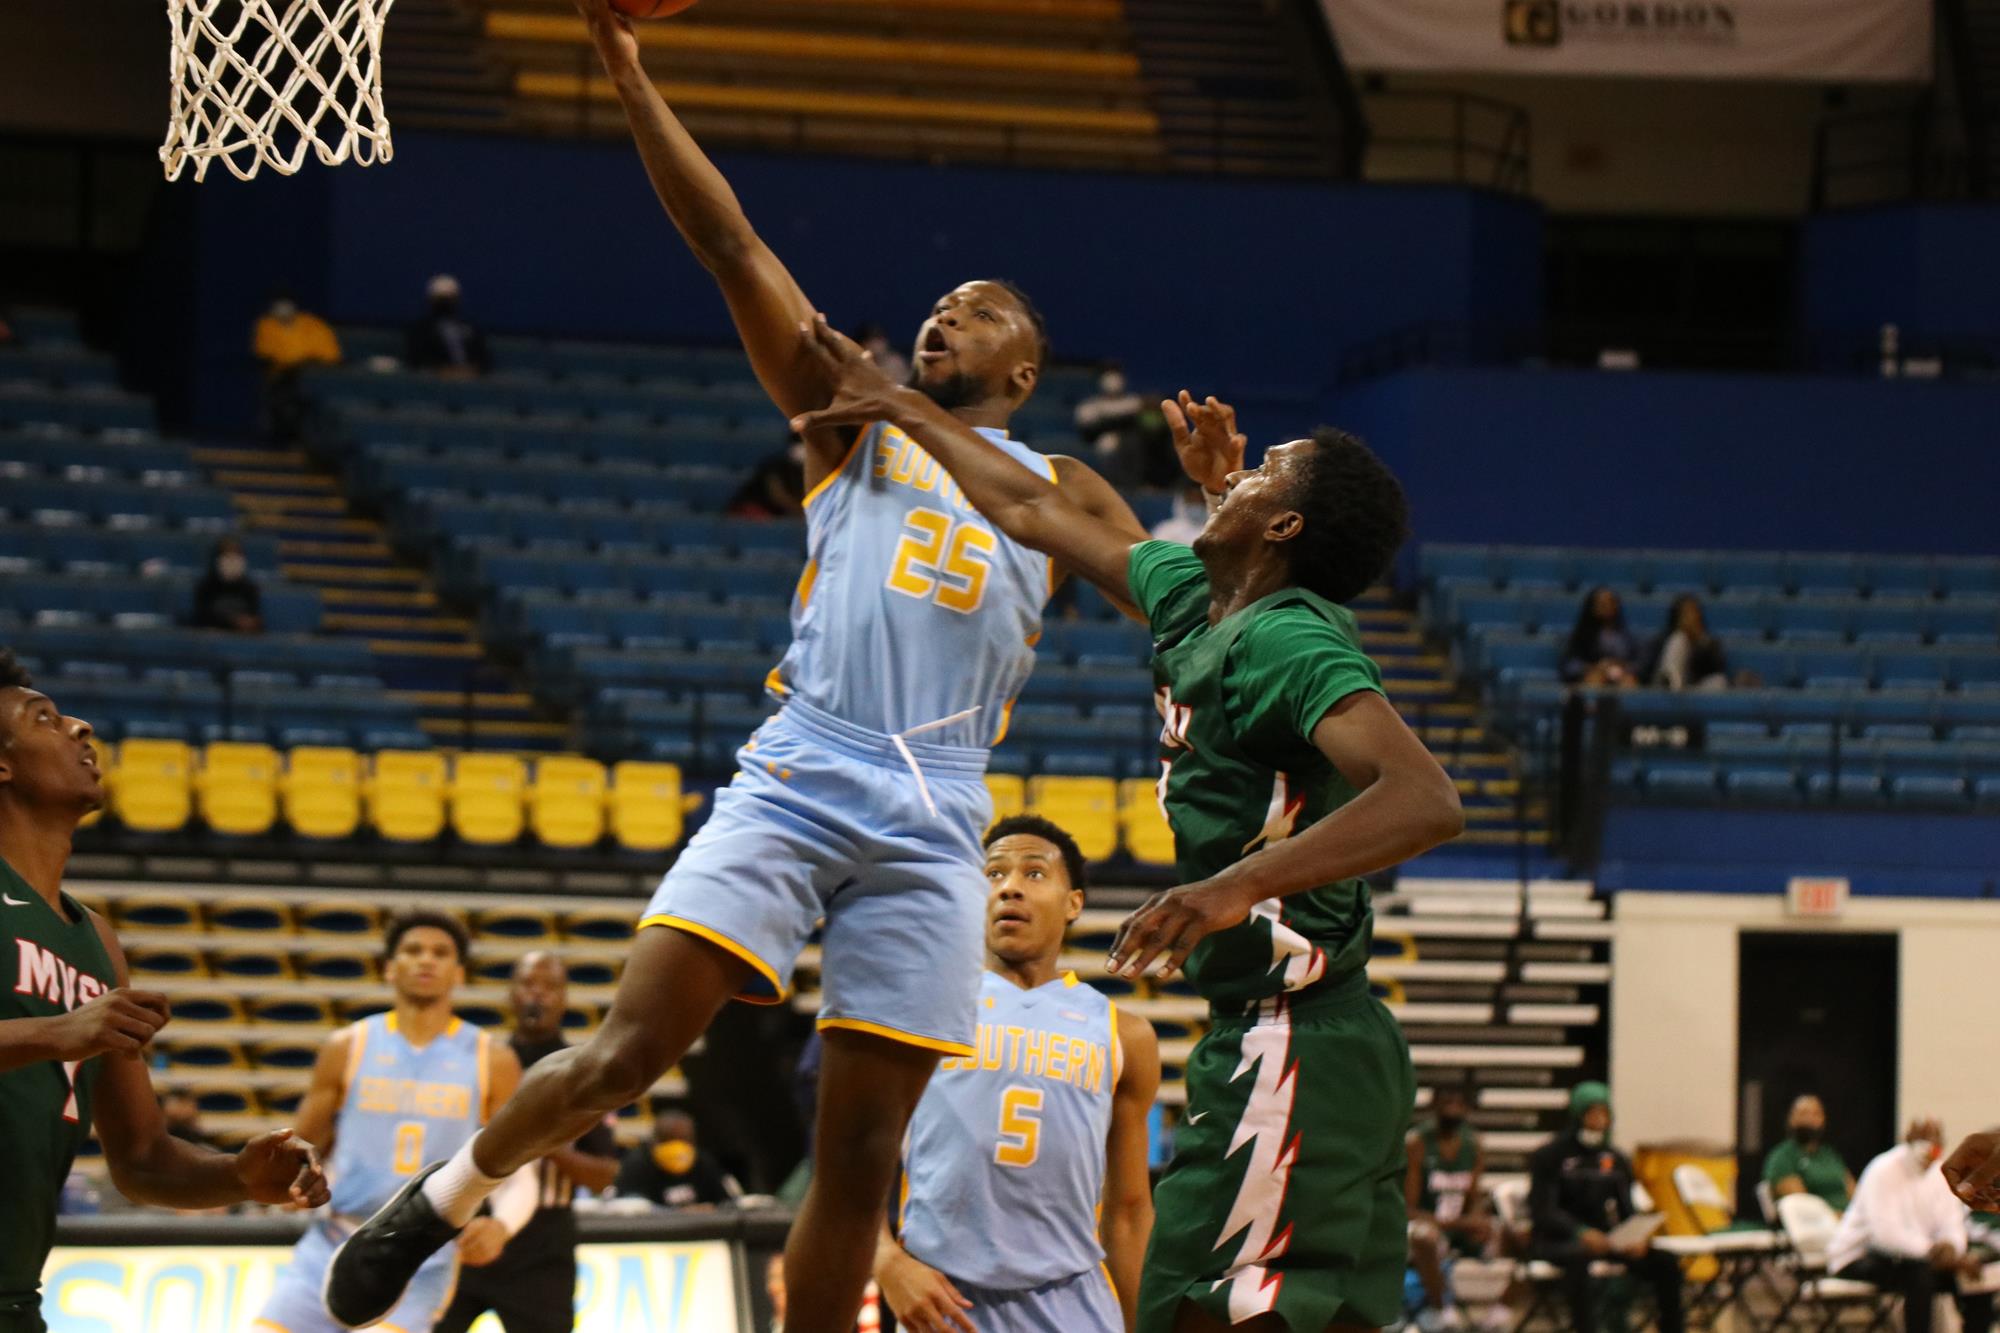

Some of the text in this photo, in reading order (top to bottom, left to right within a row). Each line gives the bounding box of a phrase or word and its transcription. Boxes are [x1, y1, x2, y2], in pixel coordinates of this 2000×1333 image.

[1565, 4, 1736, 28] GORDON
[884, 506, 998, 615] 25
[14, 937, 110, 1013] MVS
[357, 1076, 472, 1120] SOUTHERN
[993, 1084, 1045, 1169] 5
[393, 1121, 427, 1177] 0
